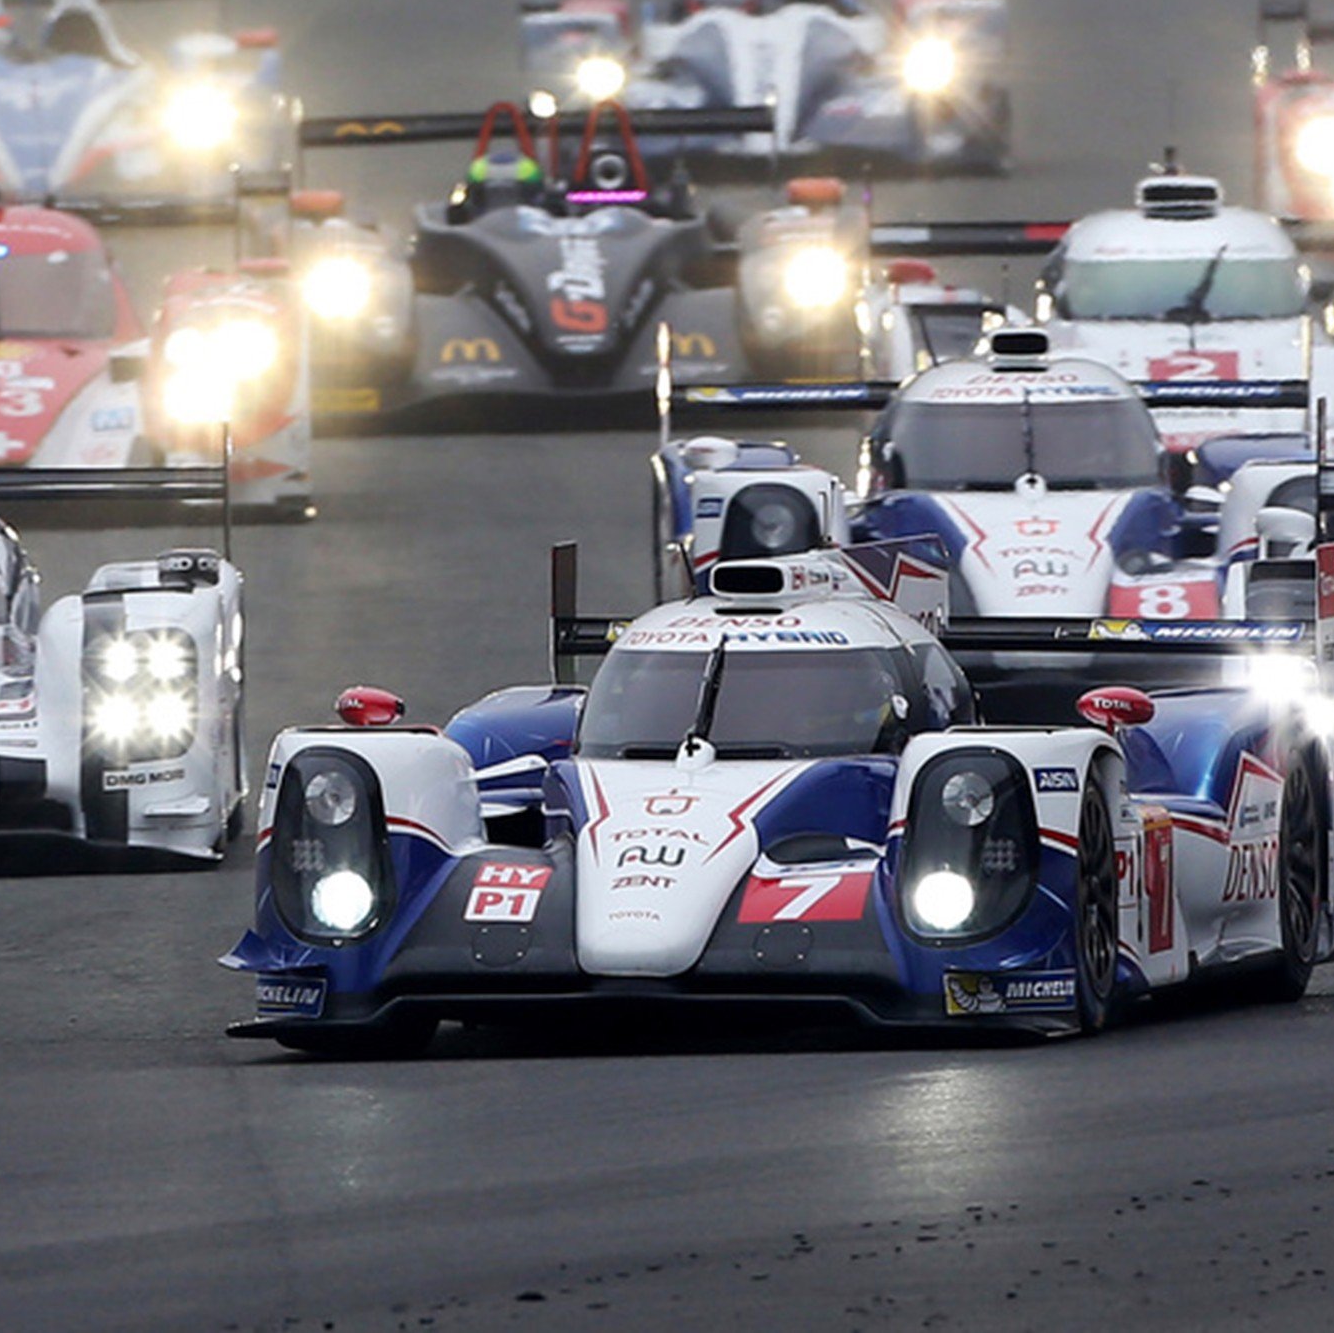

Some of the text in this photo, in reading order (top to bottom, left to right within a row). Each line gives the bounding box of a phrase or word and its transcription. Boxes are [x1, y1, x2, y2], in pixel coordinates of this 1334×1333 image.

[1168, 355, 1222, 380] 2
[997, 546, 1085, 561] TOTAL
[1138, 584, 1191, 620] 8
[668, 616, 801, 628] DENSO
[626, 631, 849, 645] TOYOTA HYBRID
[1154, 626, 1298, 639] MICHELIN
[1092, 697, 1133, 711] TOTAL
[106, 774, 146, 787] DMG
[610, 827, 710, 847] TOTAL
[479, 865, 549, 884] HY
[611, 874, 677, 890] ZENT
[473, 891, 527, 916] P1
[771, 874, 843, 920] 7
